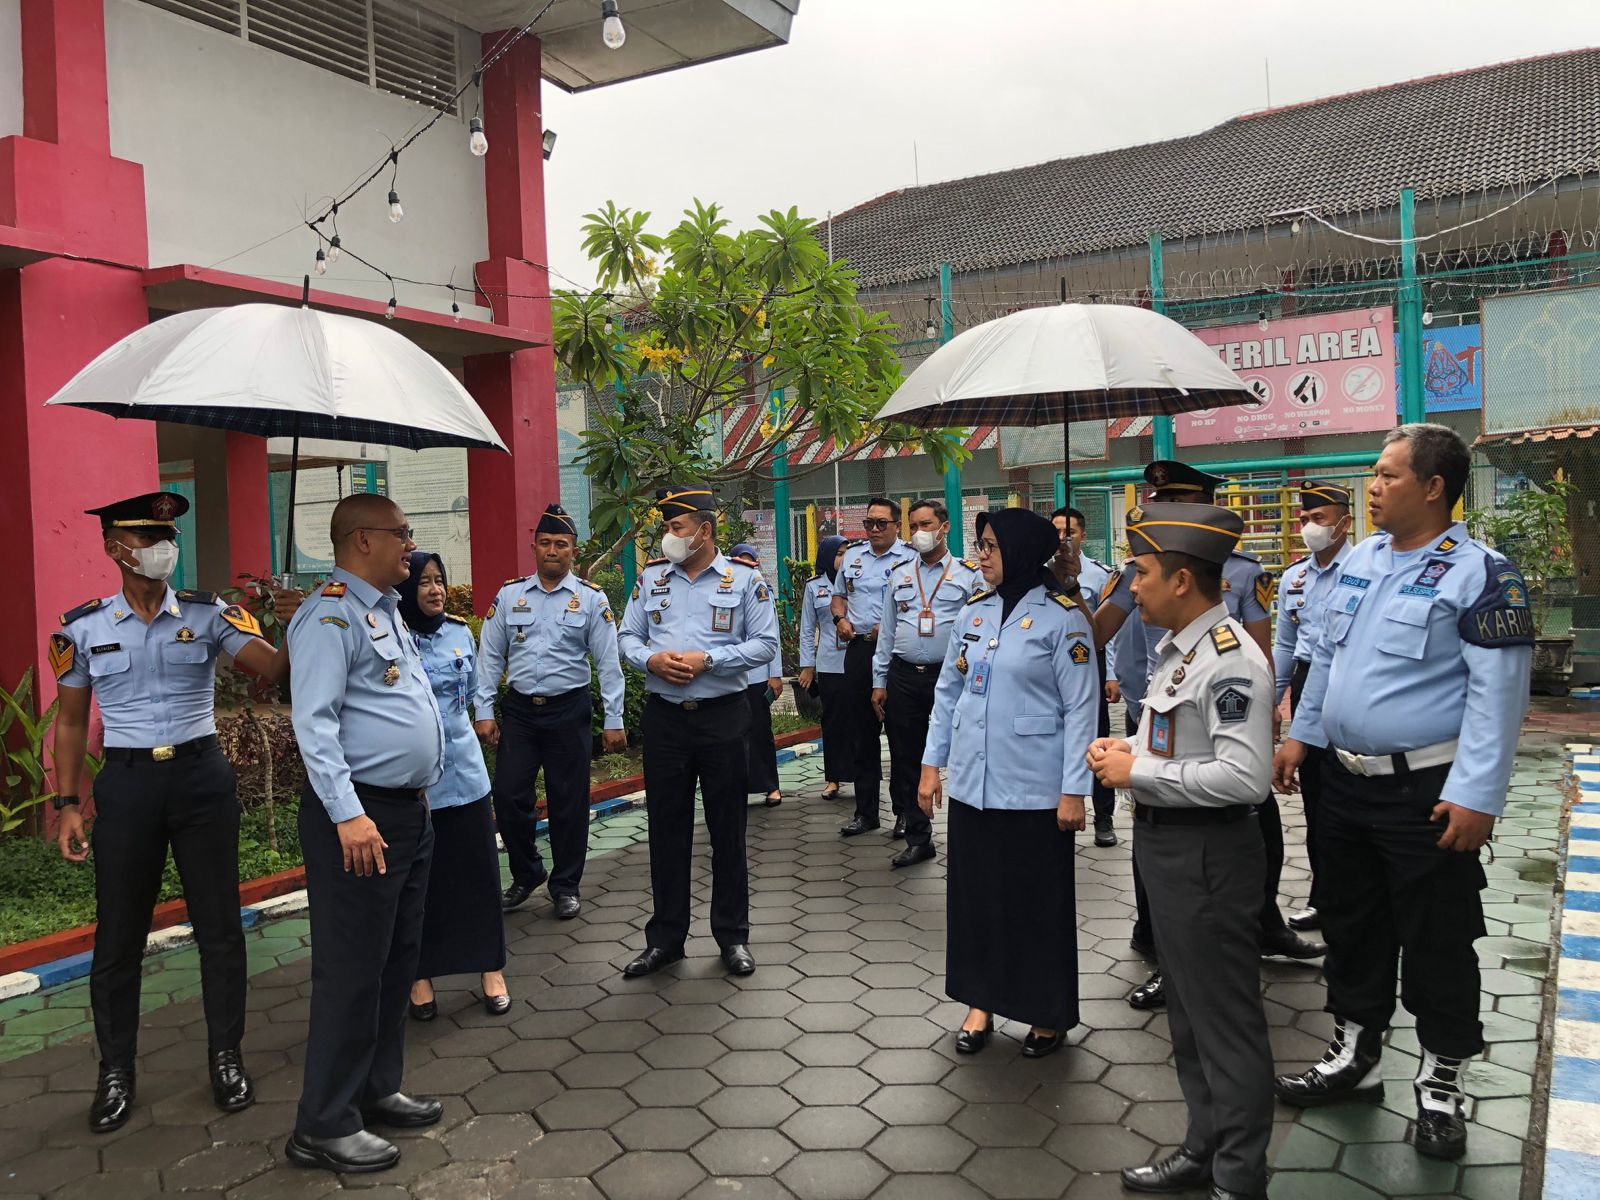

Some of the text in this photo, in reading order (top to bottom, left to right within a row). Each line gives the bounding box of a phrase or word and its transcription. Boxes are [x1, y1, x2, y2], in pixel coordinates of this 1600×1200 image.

[1208, 326, 1383, 371] TERIL AREA
[1355, 404, 1385, 413] MONEY
[1250, 413, 1275, 421] DRUG
[1296, 409, 1331, 418] WEAPON
[1341, 576, 1361, 586] AGUS
